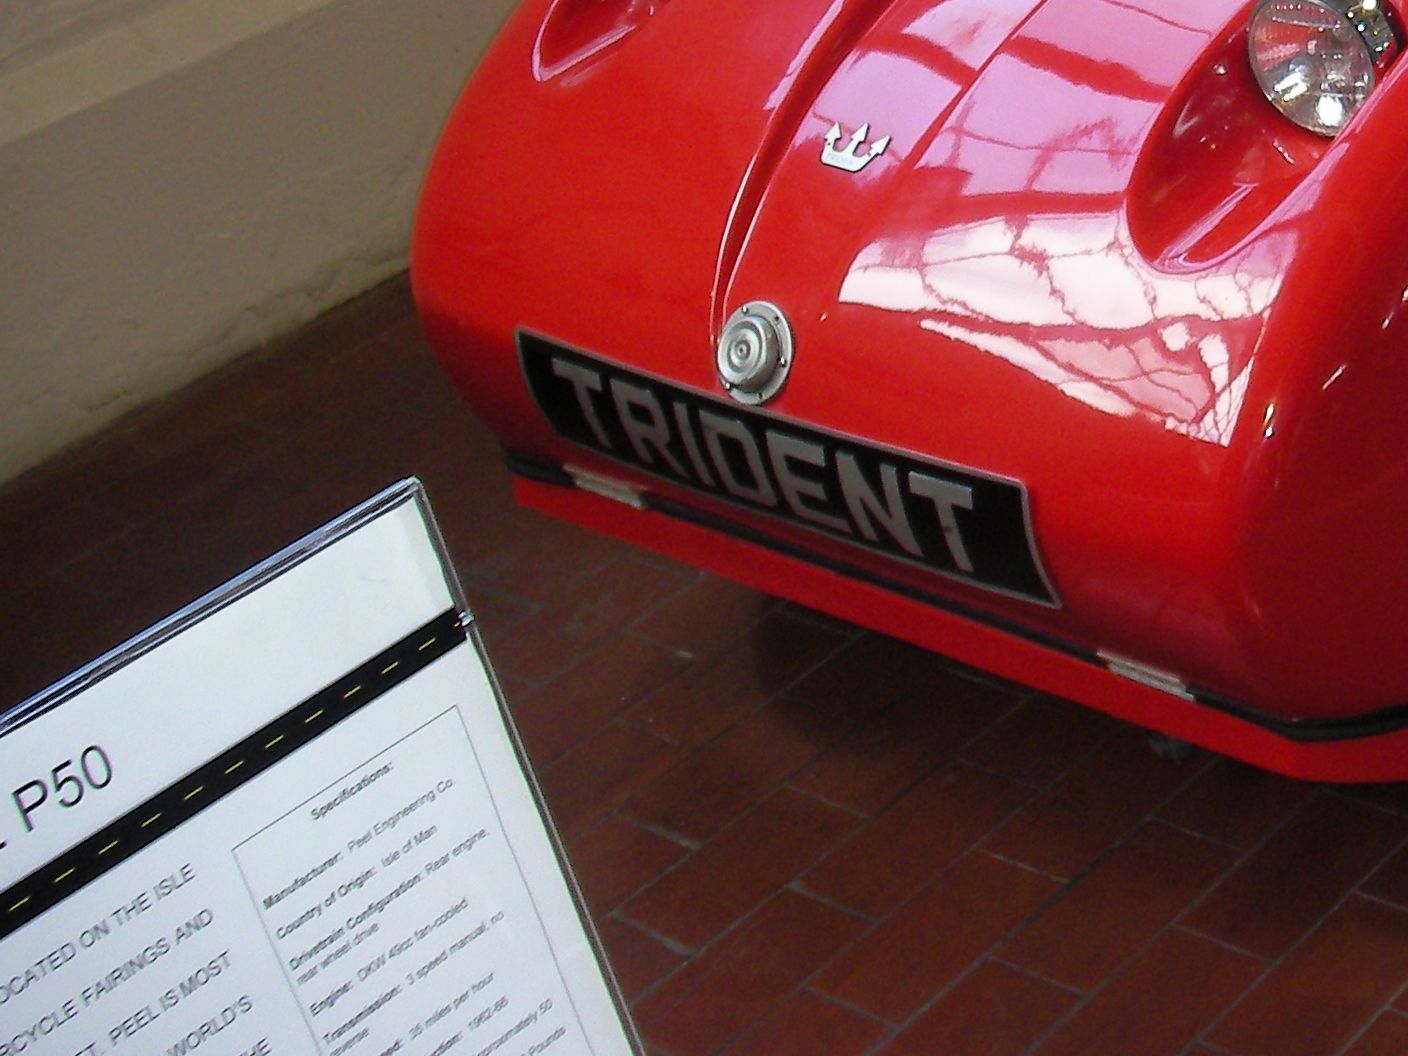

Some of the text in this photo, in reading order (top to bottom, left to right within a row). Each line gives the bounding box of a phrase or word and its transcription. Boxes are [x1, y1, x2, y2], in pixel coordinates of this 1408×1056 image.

[552, 356, 974, 573] TRIDENT
[12, 746, 112, 832] P50
[347, 830, 372, 853] Peel
[373, 790, 435, 836] Engineering
[79, 920, 110, 948] ON
[111, 892, 151, 925] THE
[153, 864, 195, 900] ISLE
[277, 904, 322, 939] Country
[324, 891, 336, 907] of
[381, 851, 401, 868] Isle
[402, 839, 413, 854] of
[413, 825, 437, 845] Man
[289, 927, 345, 971] Drivetrain
[425, 853, 450, 875] Rear
[81, 937, 170, 1007] FAIRINGS
[176, 909, 213, 945] AND
[297, 923, 379, 986] rear wheel drive
[405, 973, 415, 985] 3
[416, 950, 448, 979] speed
[490, 911, 504, 925] no
[453, 990, 469, 1010] per
[471, 972, 494, 994] hour
[109, 951, 229, 1046] PEEL IS MOST
